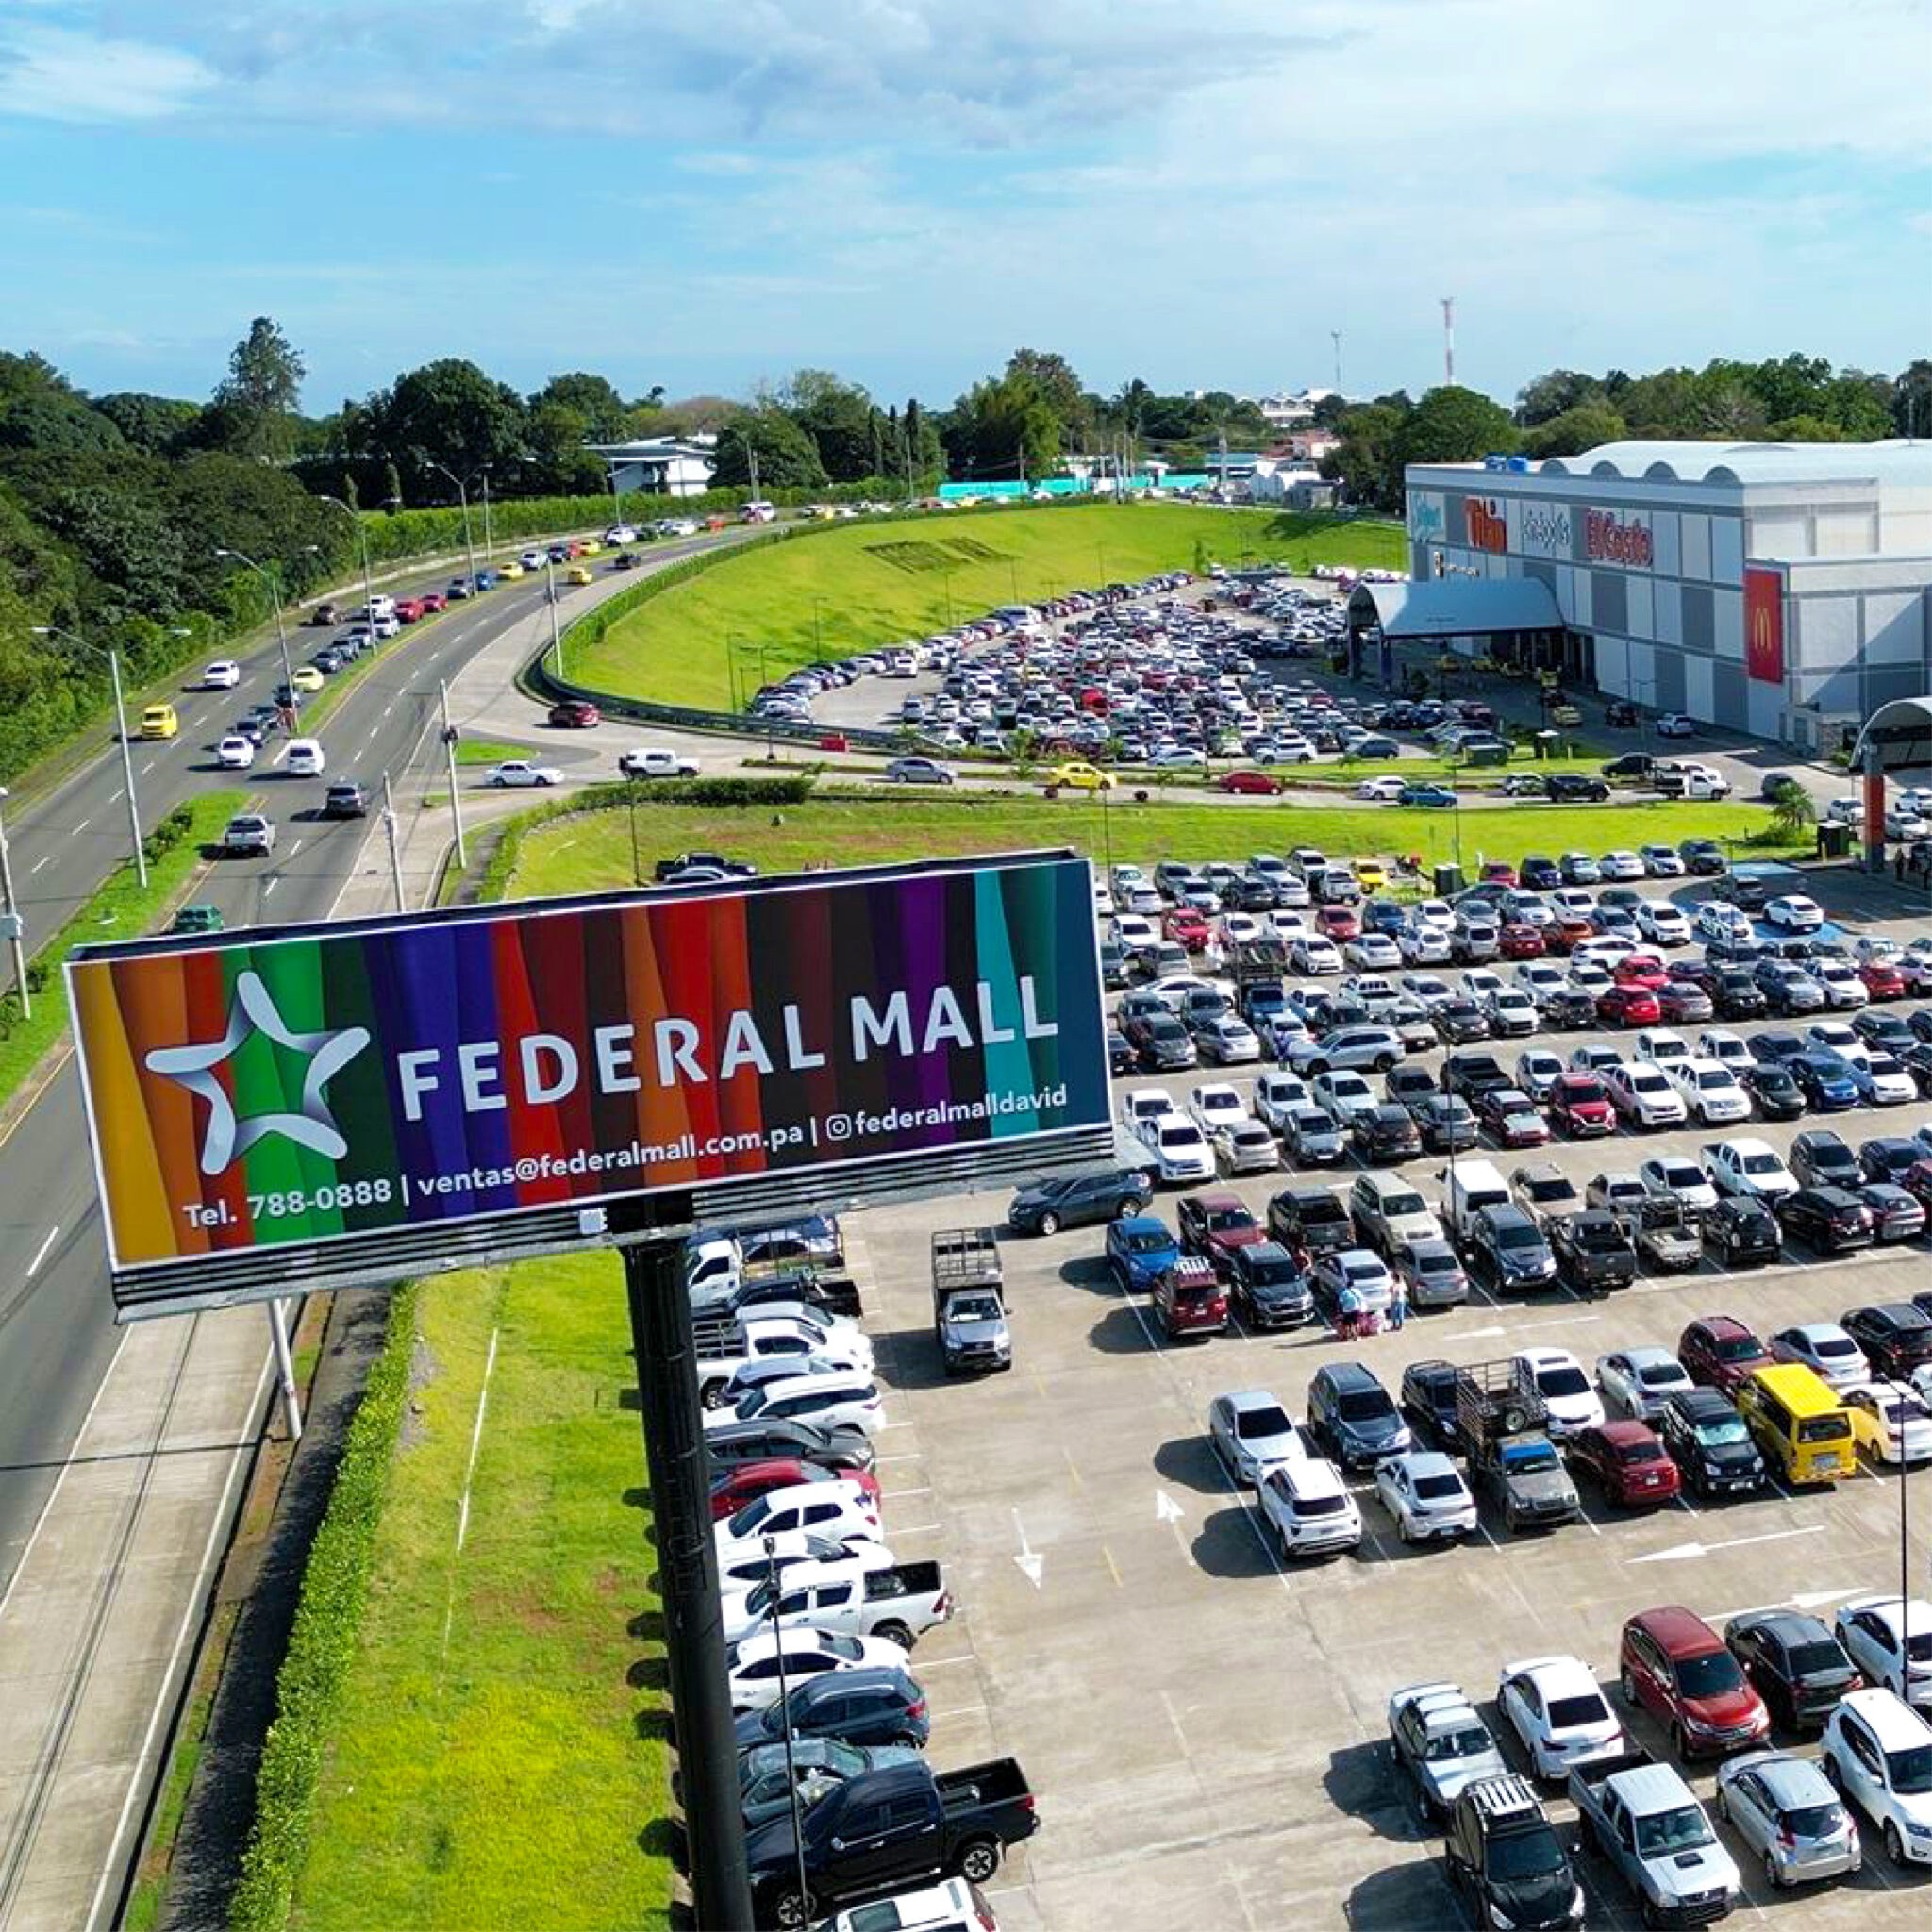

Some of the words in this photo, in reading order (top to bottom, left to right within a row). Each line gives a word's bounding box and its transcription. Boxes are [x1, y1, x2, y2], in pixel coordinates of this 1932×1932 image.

[397, 1005, 825, 1121] FEDERAL
[850, 975, 1058, 1062] MALL
[182, 1198, 238, 1228] Tel.
[246, 1178, 392, 1220] 788-0888
[417, 1123, 804, 1196] ventas@federalmall.com.pa
[855, 1082, 1067, 1135] federalmalldavid
